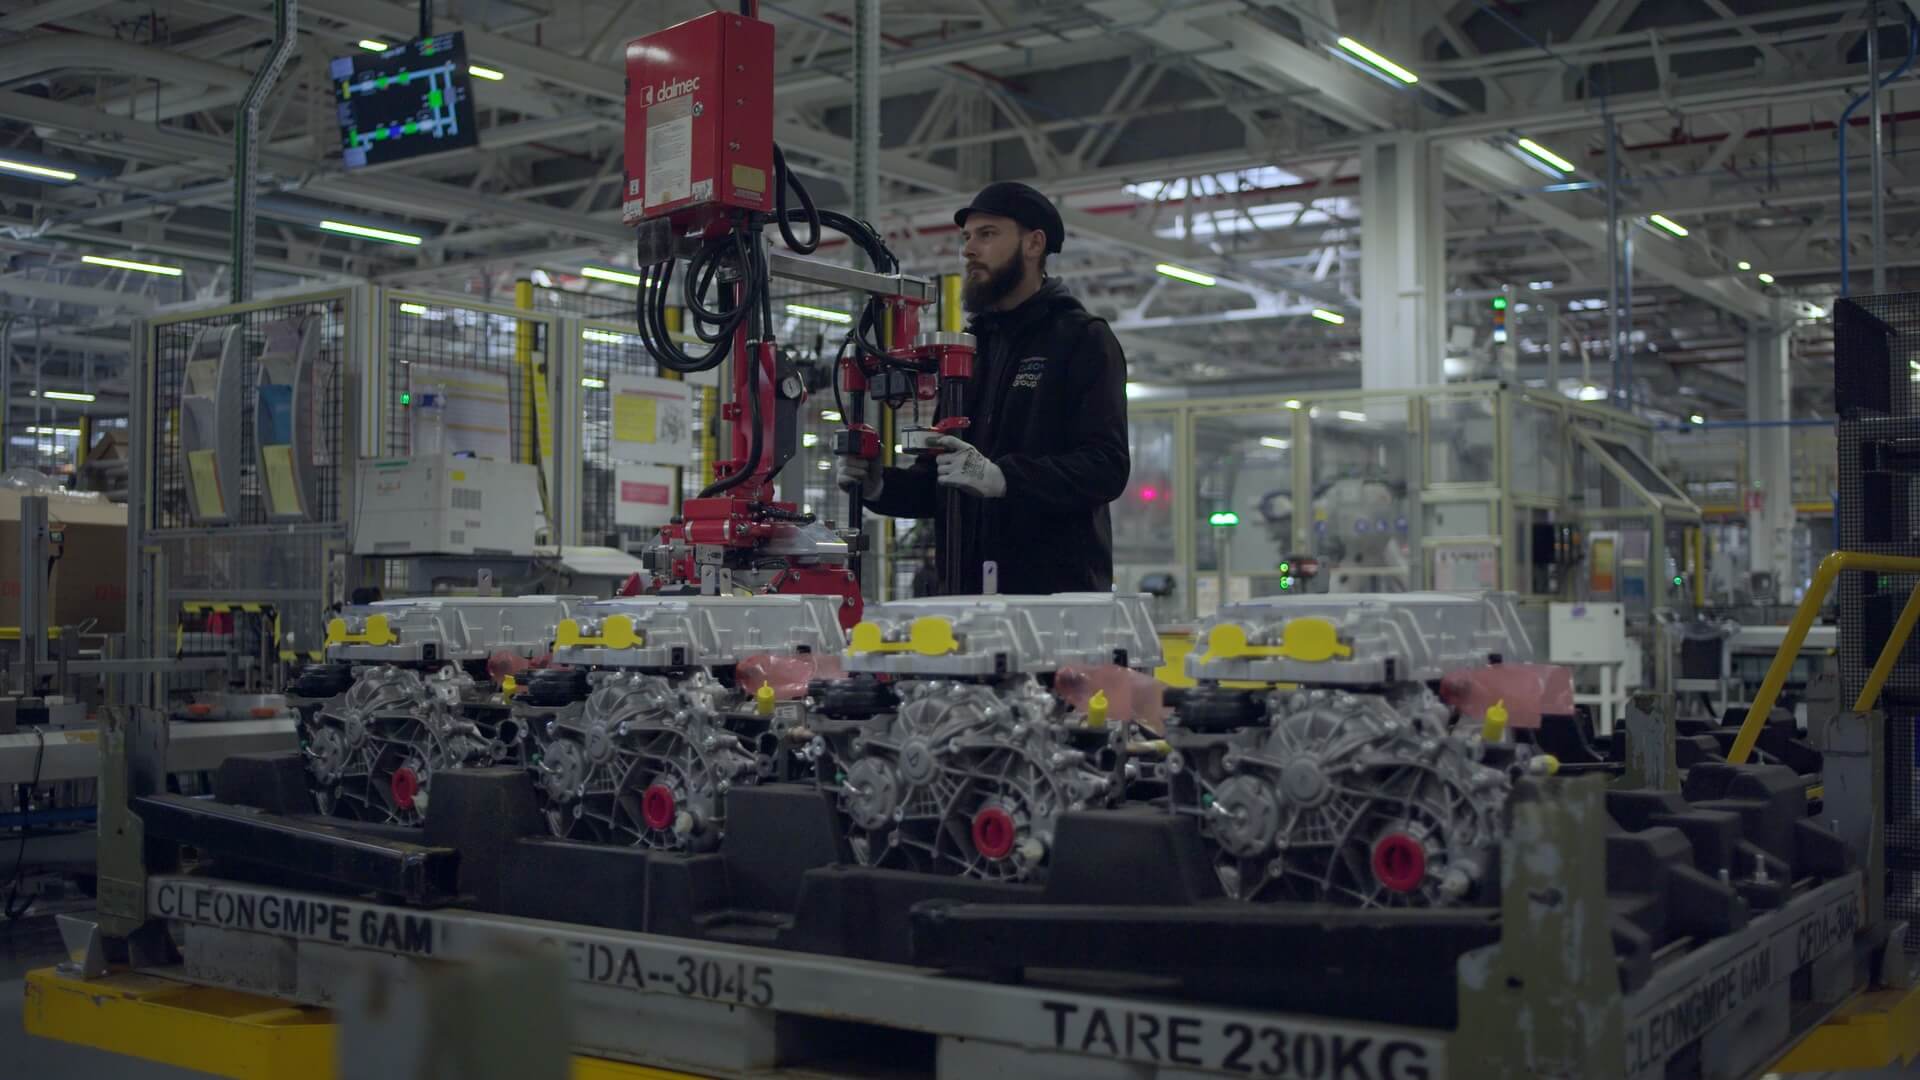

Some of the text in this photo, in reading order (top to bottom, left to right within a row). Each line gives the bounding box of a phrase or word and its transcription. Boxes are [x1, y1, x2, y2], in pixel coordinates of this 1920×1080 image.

[657, 77, 700, 101] dalmec
[158, 884, 432, 953] CLEONGMPE 6AM
[1043, 1001, 1428, 1080] TARE 230KG
